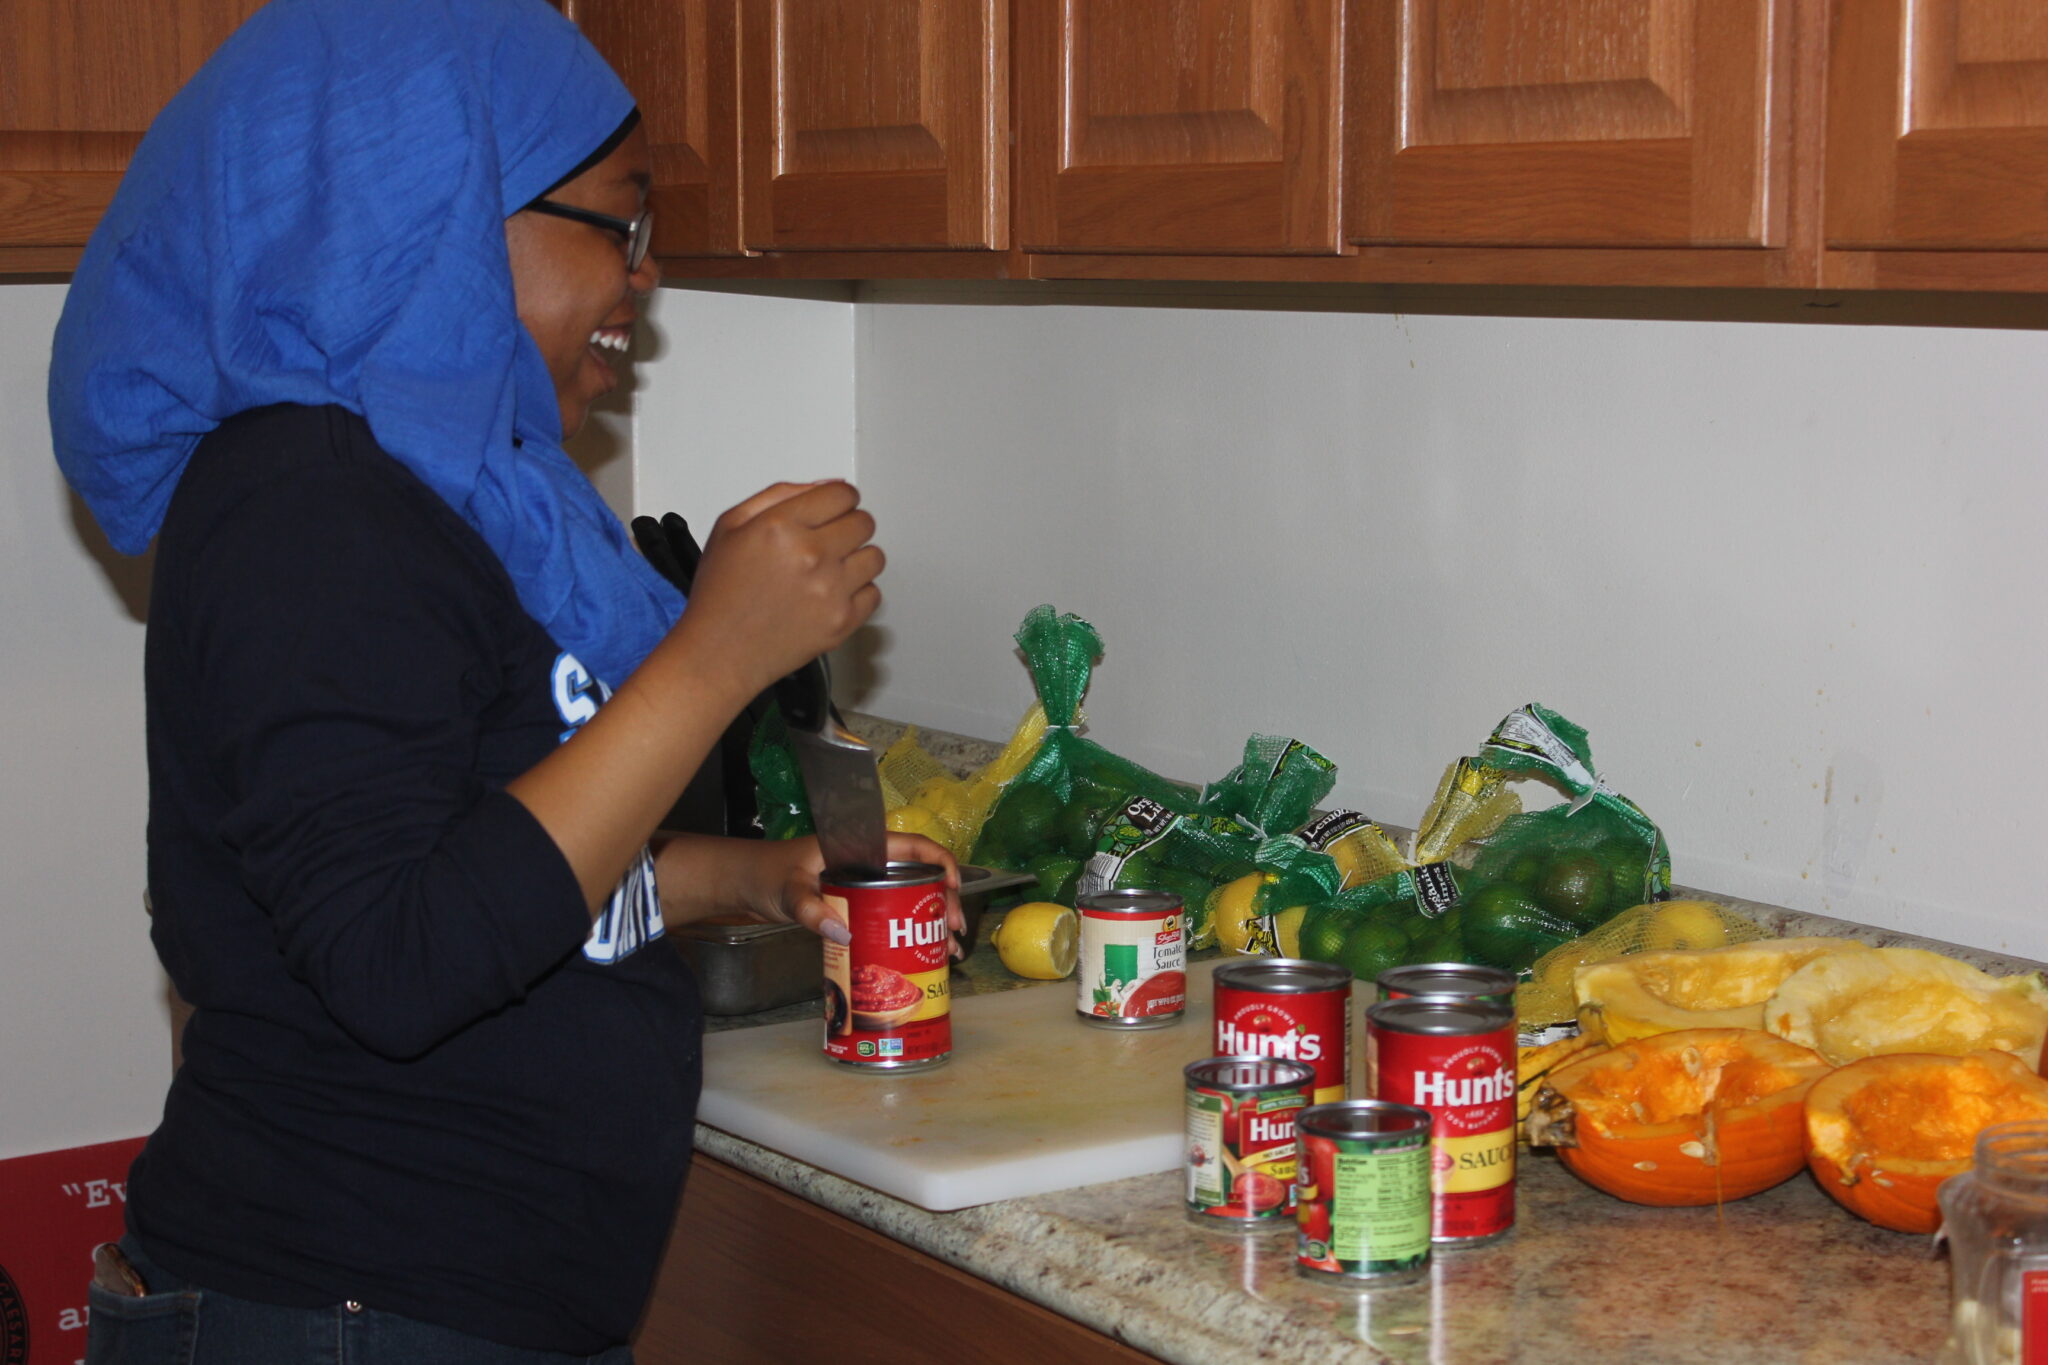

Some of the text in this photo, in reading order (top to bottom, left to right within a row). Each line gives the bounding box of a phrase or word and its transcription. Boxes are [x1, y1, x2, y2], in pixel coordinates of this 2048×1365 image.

[1153, 944, 1182, 959] Tomato
[1154, 957, 1181, 971] Sauce
[1234, 1003, 1296, 1026] PROUDLY GROWN
[1443, 1046, 1480, 1069] PROUDLY
[1443, 1110, 1465, 1130] 100%
[1459, 1145, 1513, 1170] SAUC
